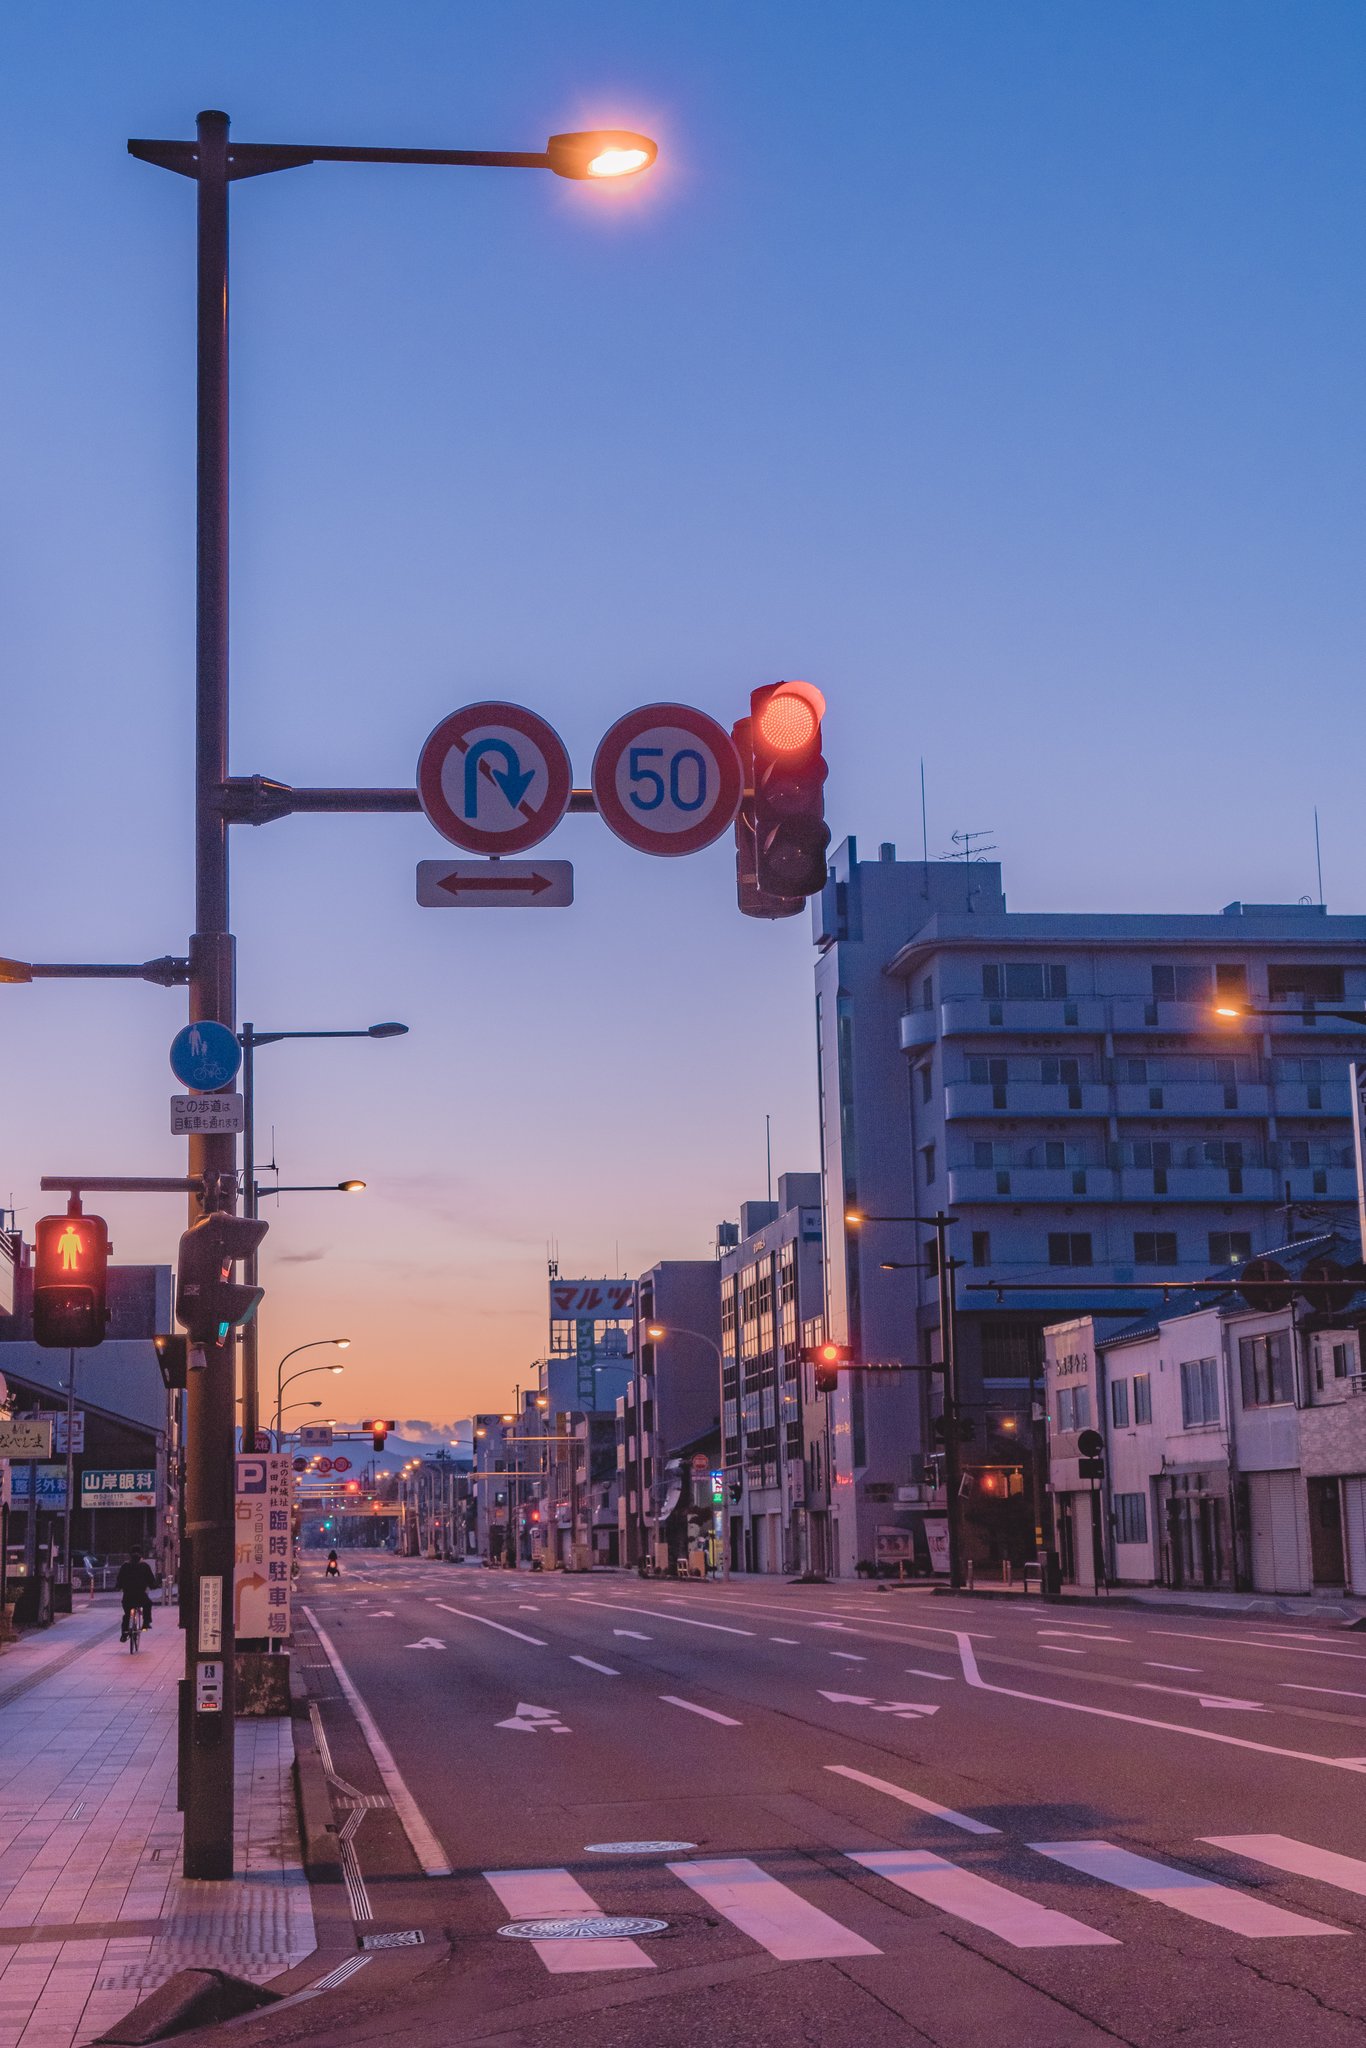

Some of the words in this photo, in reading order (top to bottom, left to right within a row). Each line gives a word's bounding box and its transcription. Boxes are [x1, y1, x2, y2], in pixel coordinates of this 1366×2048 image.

[629, 748, 706, 812] 50
[174, 1116, 239, 1130] 自転車も通れます
[175, 1099, 231, 1113] この歩道は
[553, 1287, 634, 1311] マルツ
[85, 1472, 153, 1490] 山岸眼科
[237, 1463, 264, 1492] P
[269, 1460, 279, 1507] 柴田神社
[280, 1460, 289, 1507] 北の庄城址
[254, 1502, 264, 1565] 2つ目の信号
[268, 1510, 288, 1634] 臨時駐車場
